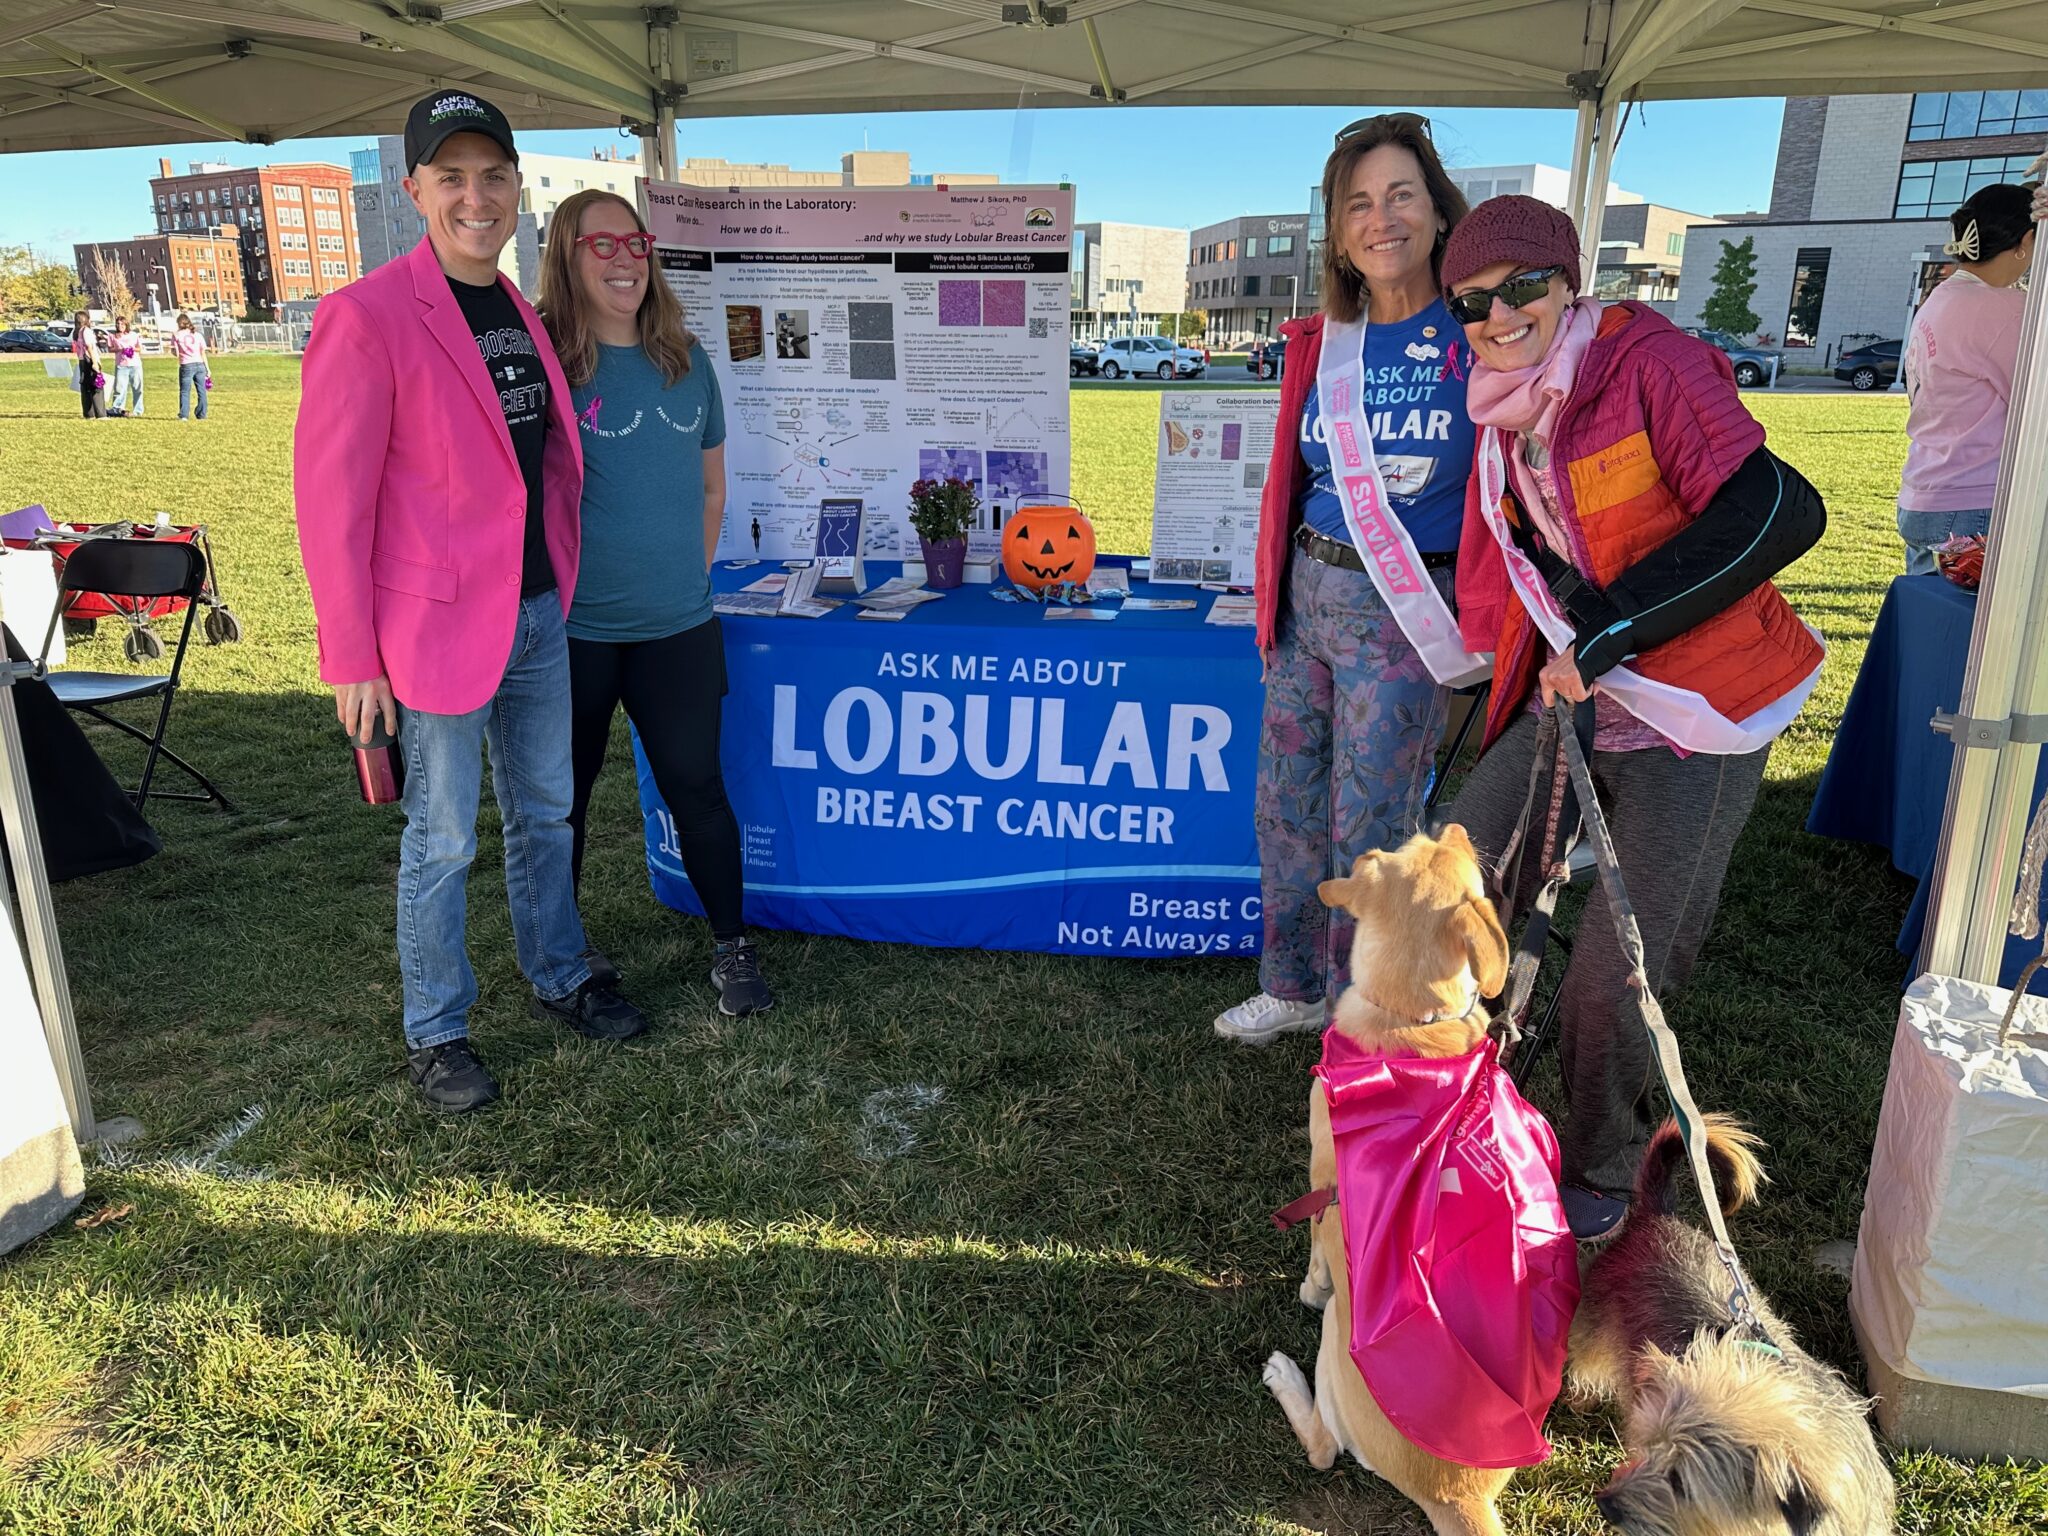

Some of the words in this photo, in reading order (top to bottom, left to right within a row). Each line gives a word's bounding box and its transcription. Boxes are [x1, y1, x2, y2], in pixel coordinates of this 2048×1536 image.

[435, 95, 477, 107] CANCER
[431, 103, 485, 117] RESEARCH
[694, 197, 746, 210] Research
[749, 198, 760, 209] in
[763, 198, 782, 209] the
[786, 198, 856, 212] Laboratory:
[720, 225, 741, 235] How
[743, 227, 757, 235] we
[760, 225, 772, 235] do
[1281, 221, 1304, 231] Denver
[885, 233, 904, 245] why
[924, 233, 952, 245] study
[954, 233, 993, 242] Lobular
[995, 233, 1028, 242] Breast
[1031, 233, 1066, 242] Cancer
[741, 253, 755, 262] How
[756, 253, 763, 262] do
[764, 253, 775, 262] we
[776, 253, 800, 262] actually
[801, 253, 817, 262] study
[819, 253, 838, 262] breast
[839, 253, 865, 262] cancer?
[933, 255, 948, 263] Why
[948, 255, 963, 263] does
[965, 255, 975, 263] the
[977, 255, 995, 263] Sikora
[997, 255, 1010, 263] Lab
[1012, 255, 1031, 264] study
[474, 327, 539, 362] DOCRIN
[1364, 366, 1402, 385] ASK
[1411, 365, 1444, 383] ME
[499, 381, 546, 415] CIETY
[1363, 386, 1437, 406] ABOUT
[1301, 408, 1452, 444] LOULAR
[594, 429, 616, 438] HEY
[1352, 481, 1411, 595] Survivor
[877, 651, 939, 681] ASK
[951, 655, 1000, 683] ME
[1008, 657, 1127, 688] ABOUT
[772, 684, 1234, 793] LOBULAR
[816, 786, 984, 835] BREAST
[995, 798, 1177, 846] CANCER
[747, 824, 777, 834] Lobular
[748, 836, 771, 845] Breast
[748, 847, 773, 857] Cancer
[748, 858, 777, 869] Alliance
[1129, 892, 1231, 921] Breast
[1240, 896, 1264, 921] C
[1057, 921, 1113, 947] Not
[1120, 925, 1231, 955] Always
[1239, 934, 1255, 949] a
